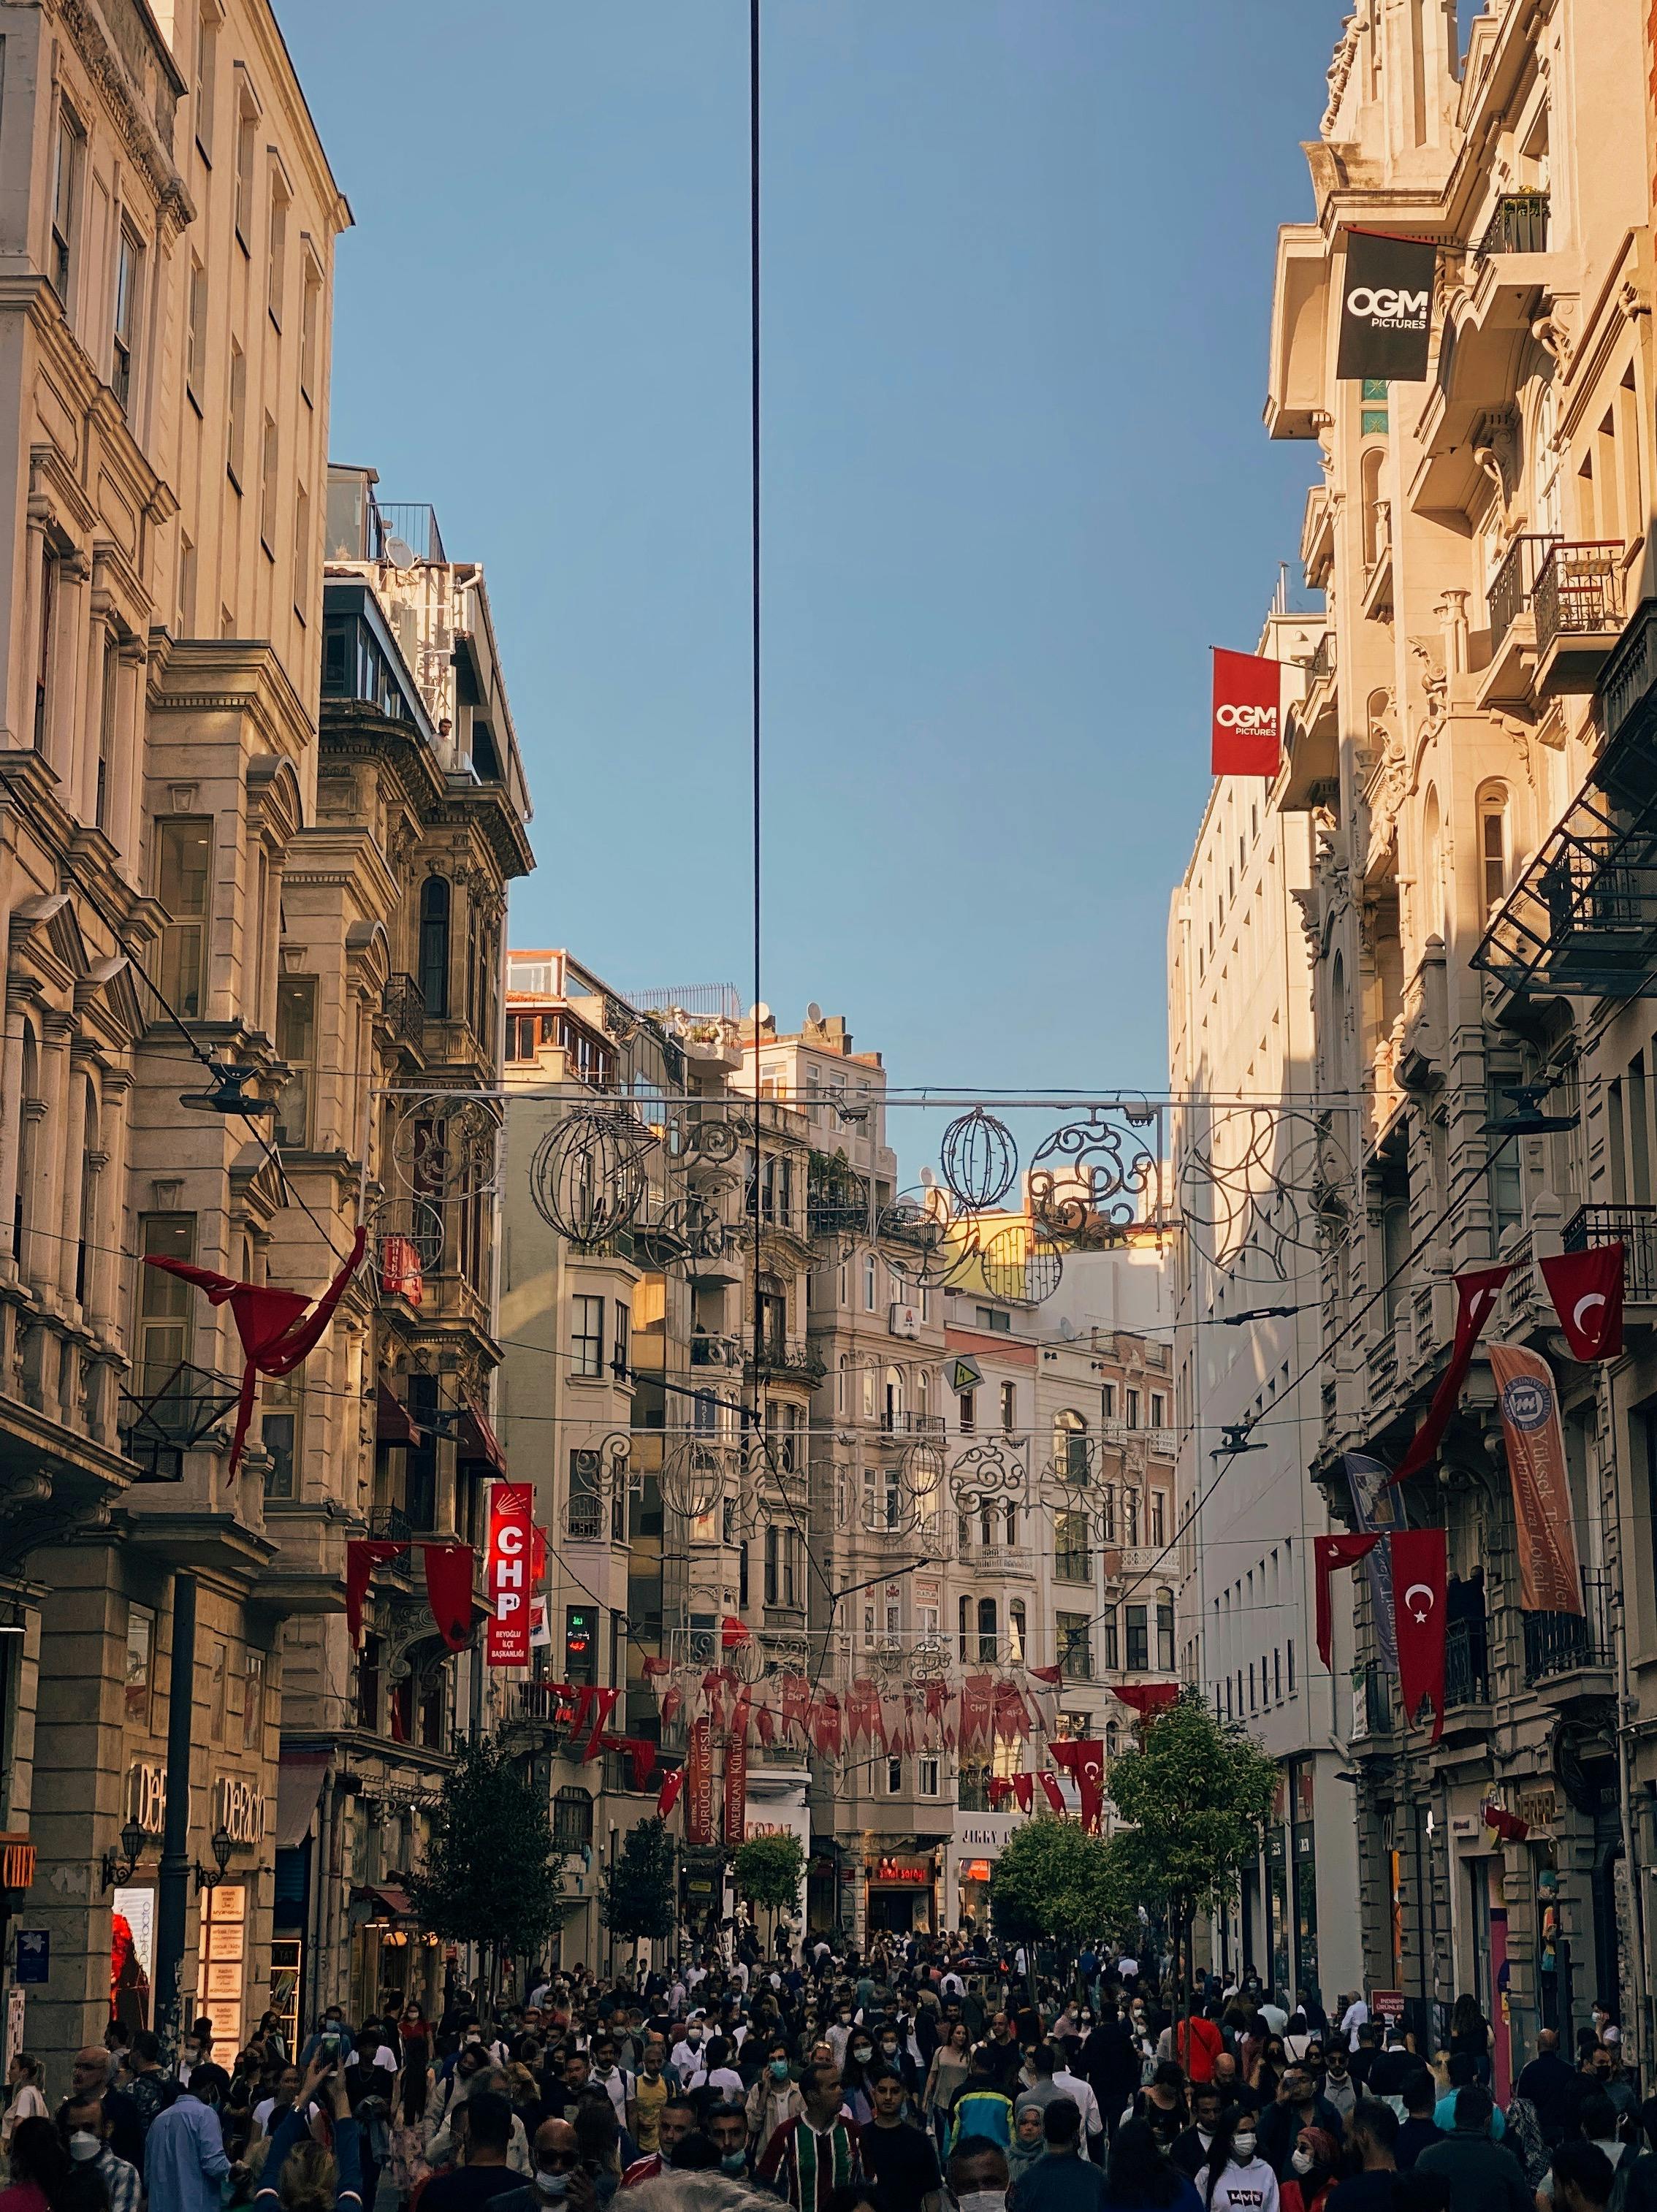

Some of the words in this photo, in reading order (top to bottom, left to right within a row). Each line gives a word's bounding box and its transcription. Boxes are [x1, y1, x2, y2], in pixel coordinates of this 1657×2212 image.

[1347, 287, 1428, 319] OGM
[1371, 318, 1426, 329] PICTURES
[1216, 704, 1277, 729] OGM
[1235, 728, 1276, 736] PICTURES
[1532, 1428, 1555, 1500] Yüksek
[497, 1526, 523, 1621] CHP
[1531, 1535, 1550, 1594] Lokali
[970, 1704, 988, 1712] CHP
[699, 1780, 711, 1837] SÜRÜCÜ
[962, 1830, 997, 1844] JIMMY
[140, 1902, 151, 1964] DeFacto
